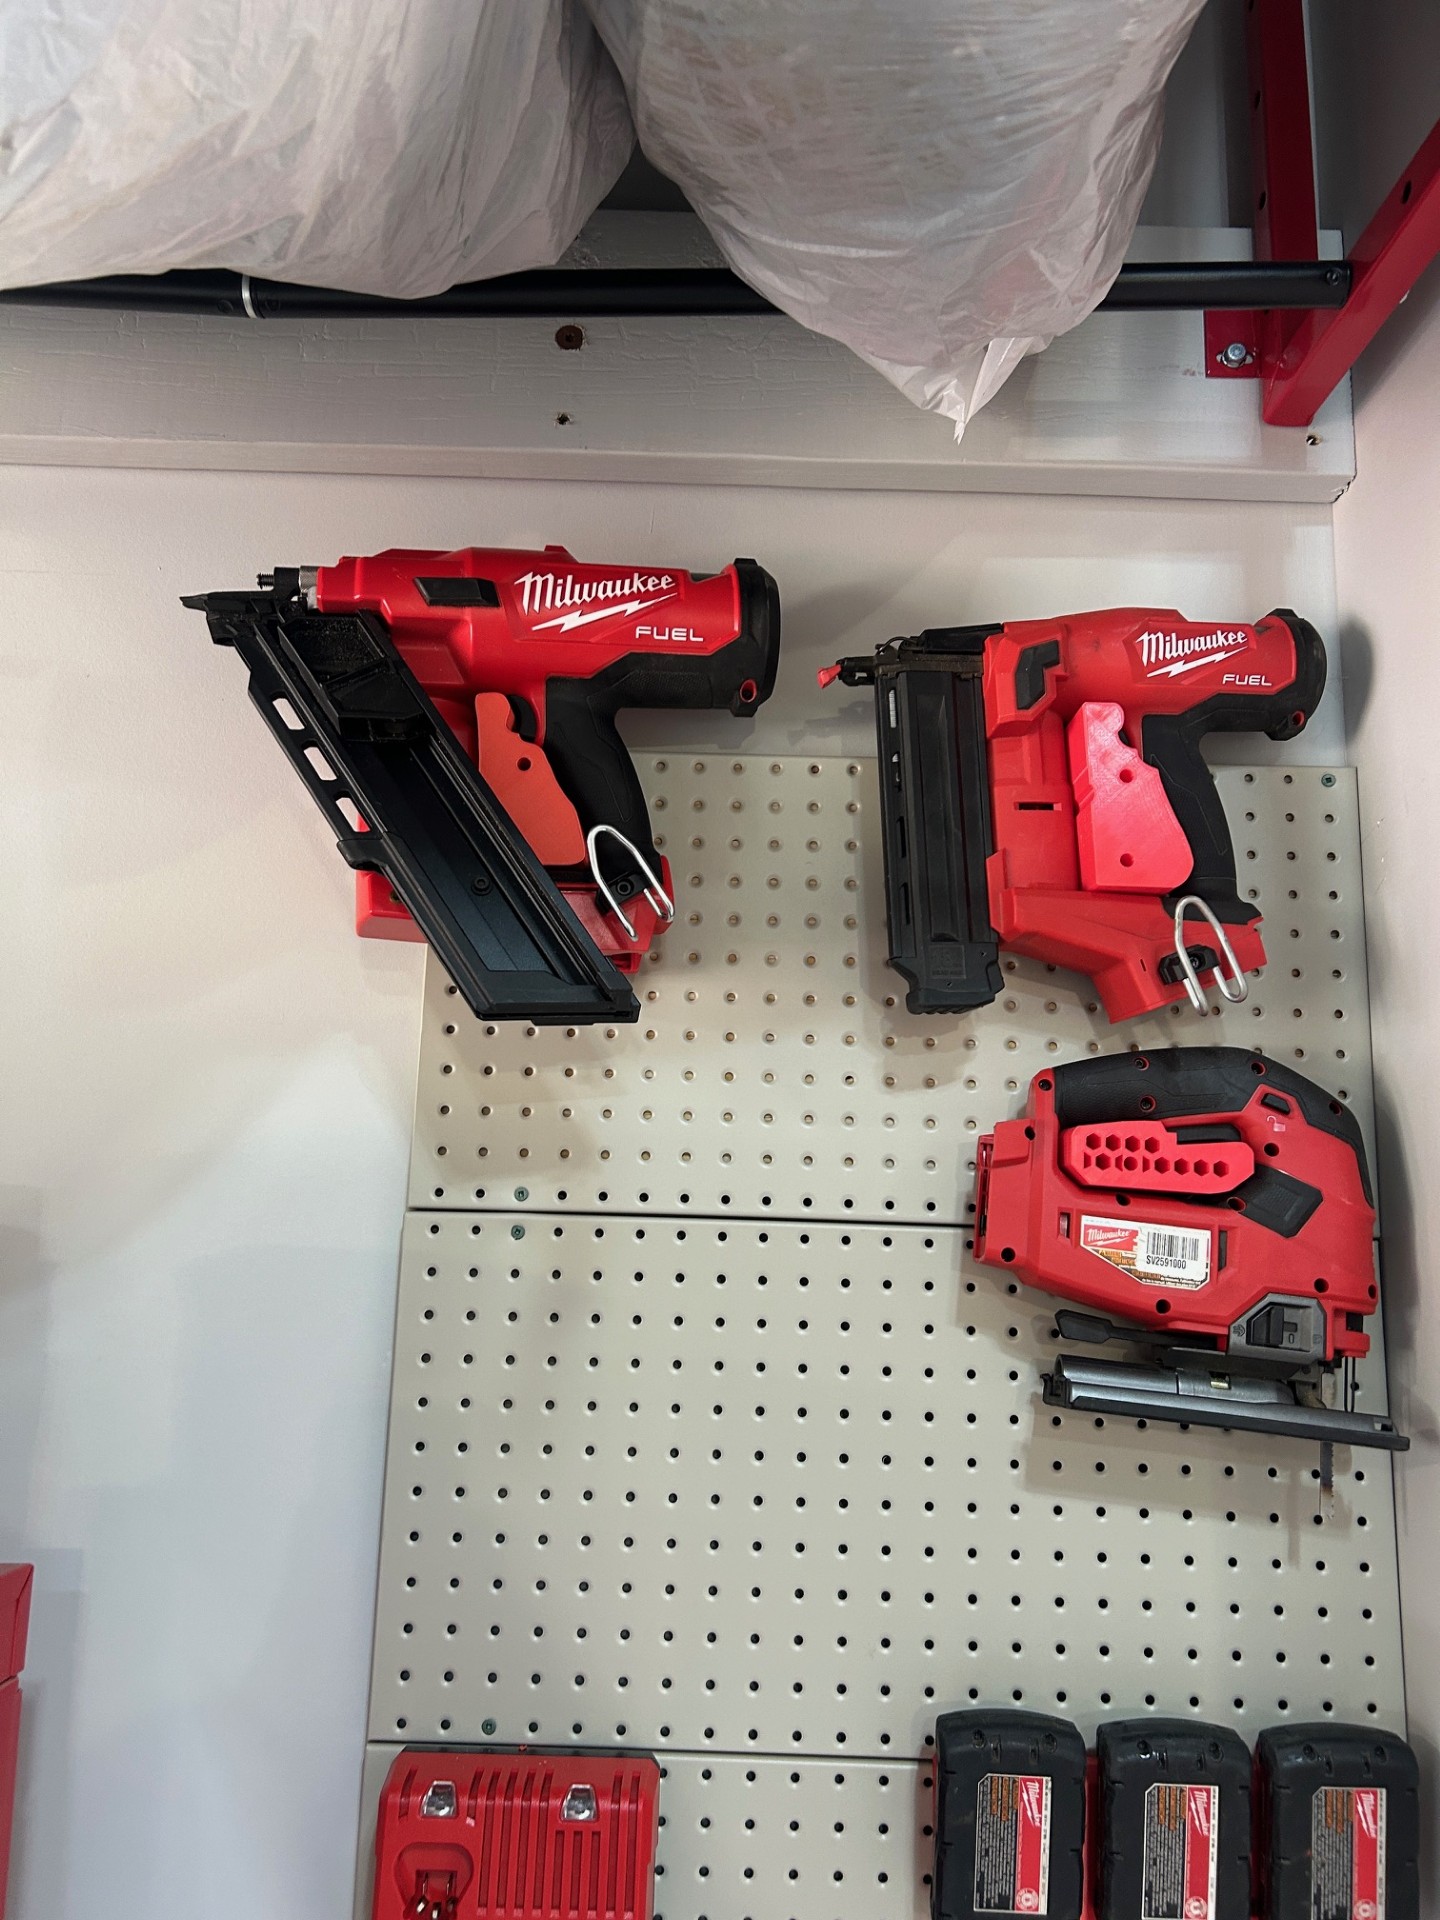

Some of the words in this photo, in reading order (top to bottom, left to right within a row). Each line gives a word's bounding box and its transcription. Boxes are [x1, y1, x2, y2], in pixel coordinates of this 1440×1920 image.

[514, 571, 675, 616] Milwaukee
[635, 626, 704, 642] FUEL
[1135, 630, 1248, 667] Milwaukee
[1222, 673, 1272, 687] FUEL
[1087, 1228, 1130, 1242] Milwaukee
[1146, 1255, 1187, 1270] SV2591000
